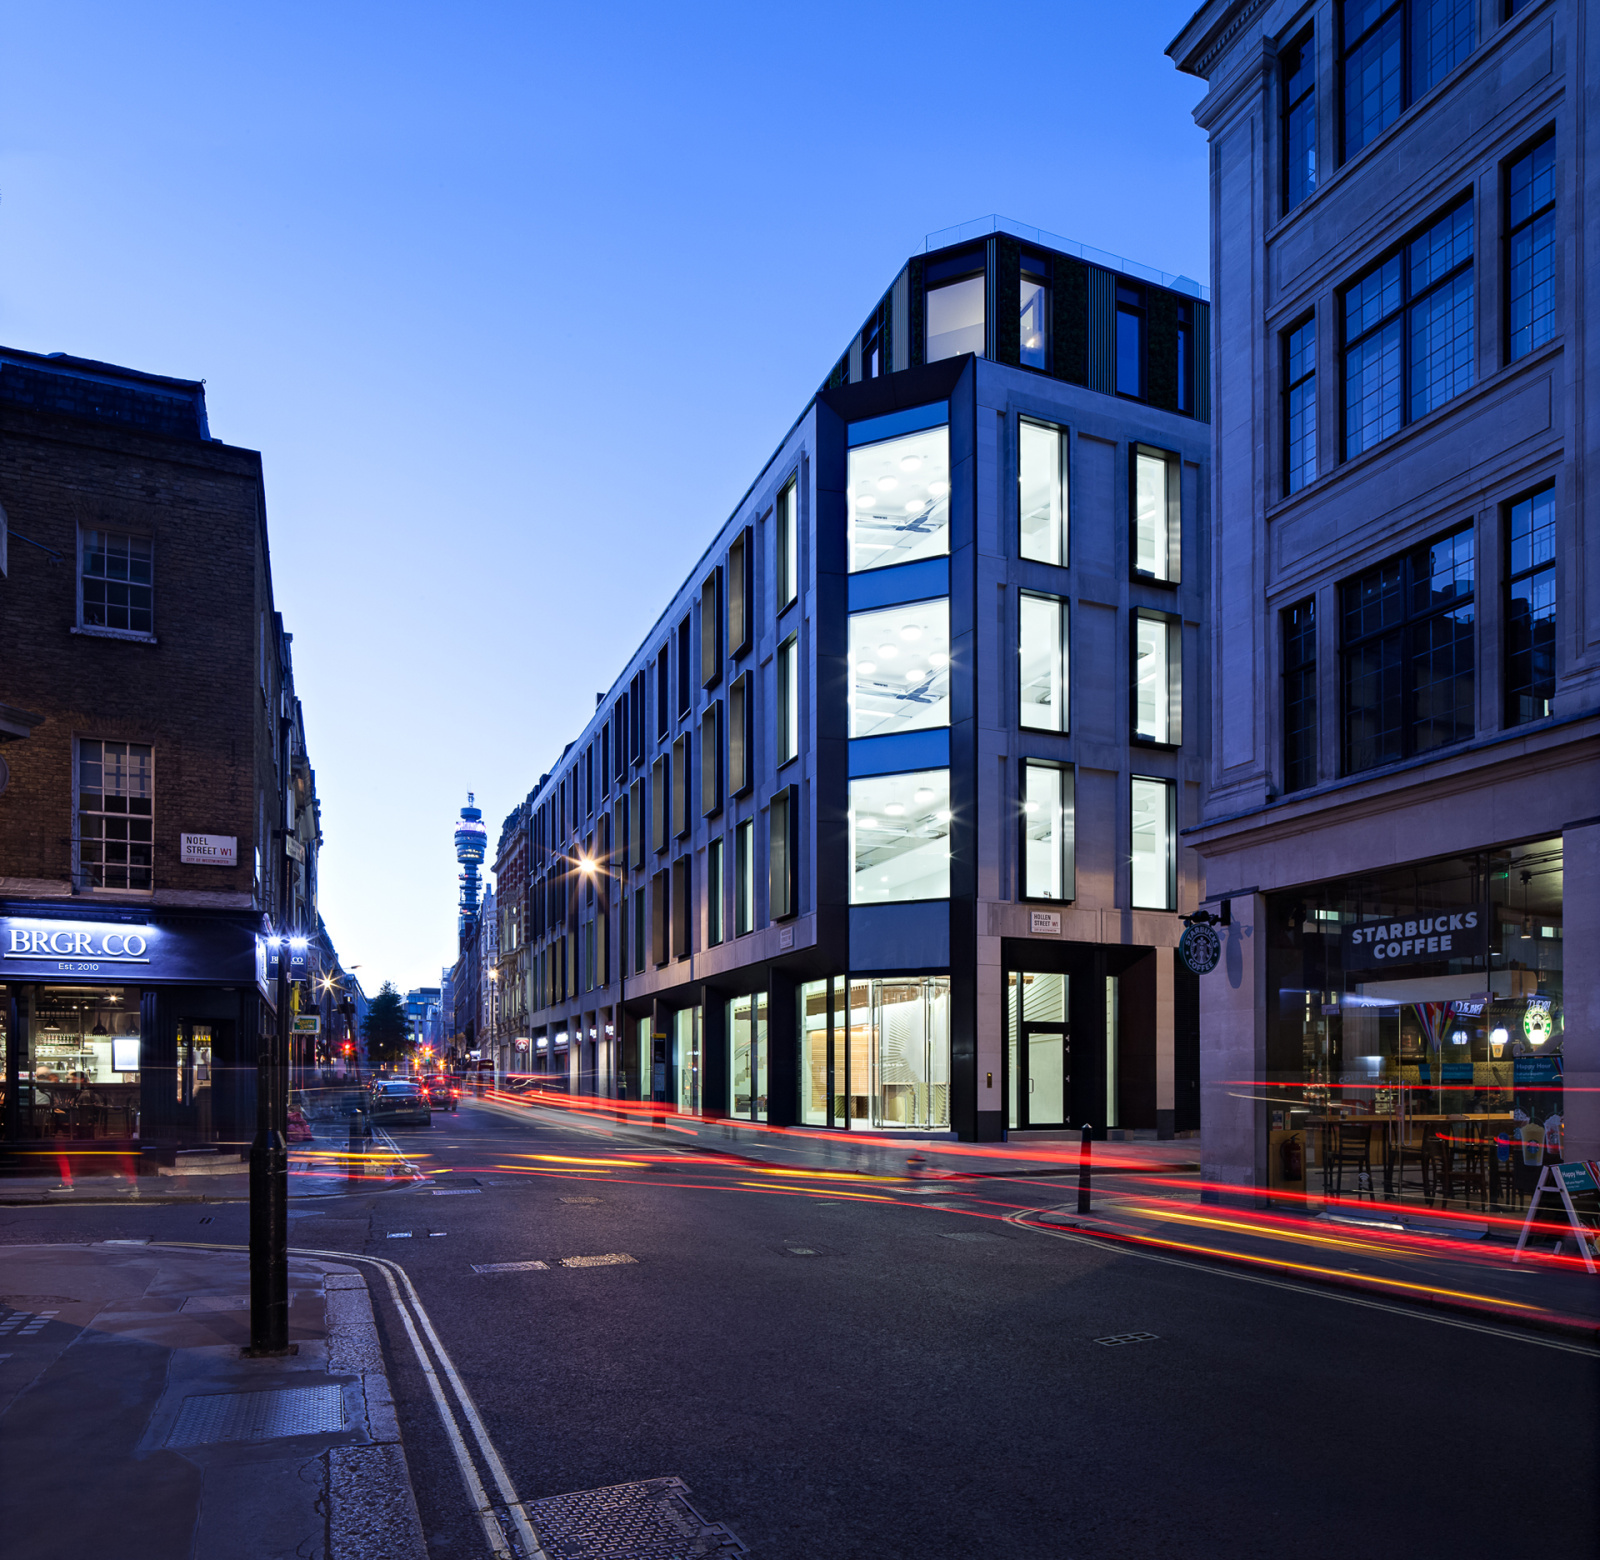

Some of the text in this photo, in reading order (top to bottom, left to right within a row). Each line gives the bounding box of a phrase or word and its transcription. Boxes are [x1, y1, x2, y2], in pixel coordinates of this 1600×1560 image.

[186, 836, 208, 845] NOEL
[186, 846, 232, 856] STREET W1
[1352, 911, 1478, 944] STARBUCKS
[8, 929, 147, 956] BRGR.CO
[1185, 926, 1219, 948] STARBUCKS
[1373, 934, 1452, 959] COFFEE
[58, 963, 99, 971] Est. 2010
[1188, 958, 1214, 972] COFFEE
